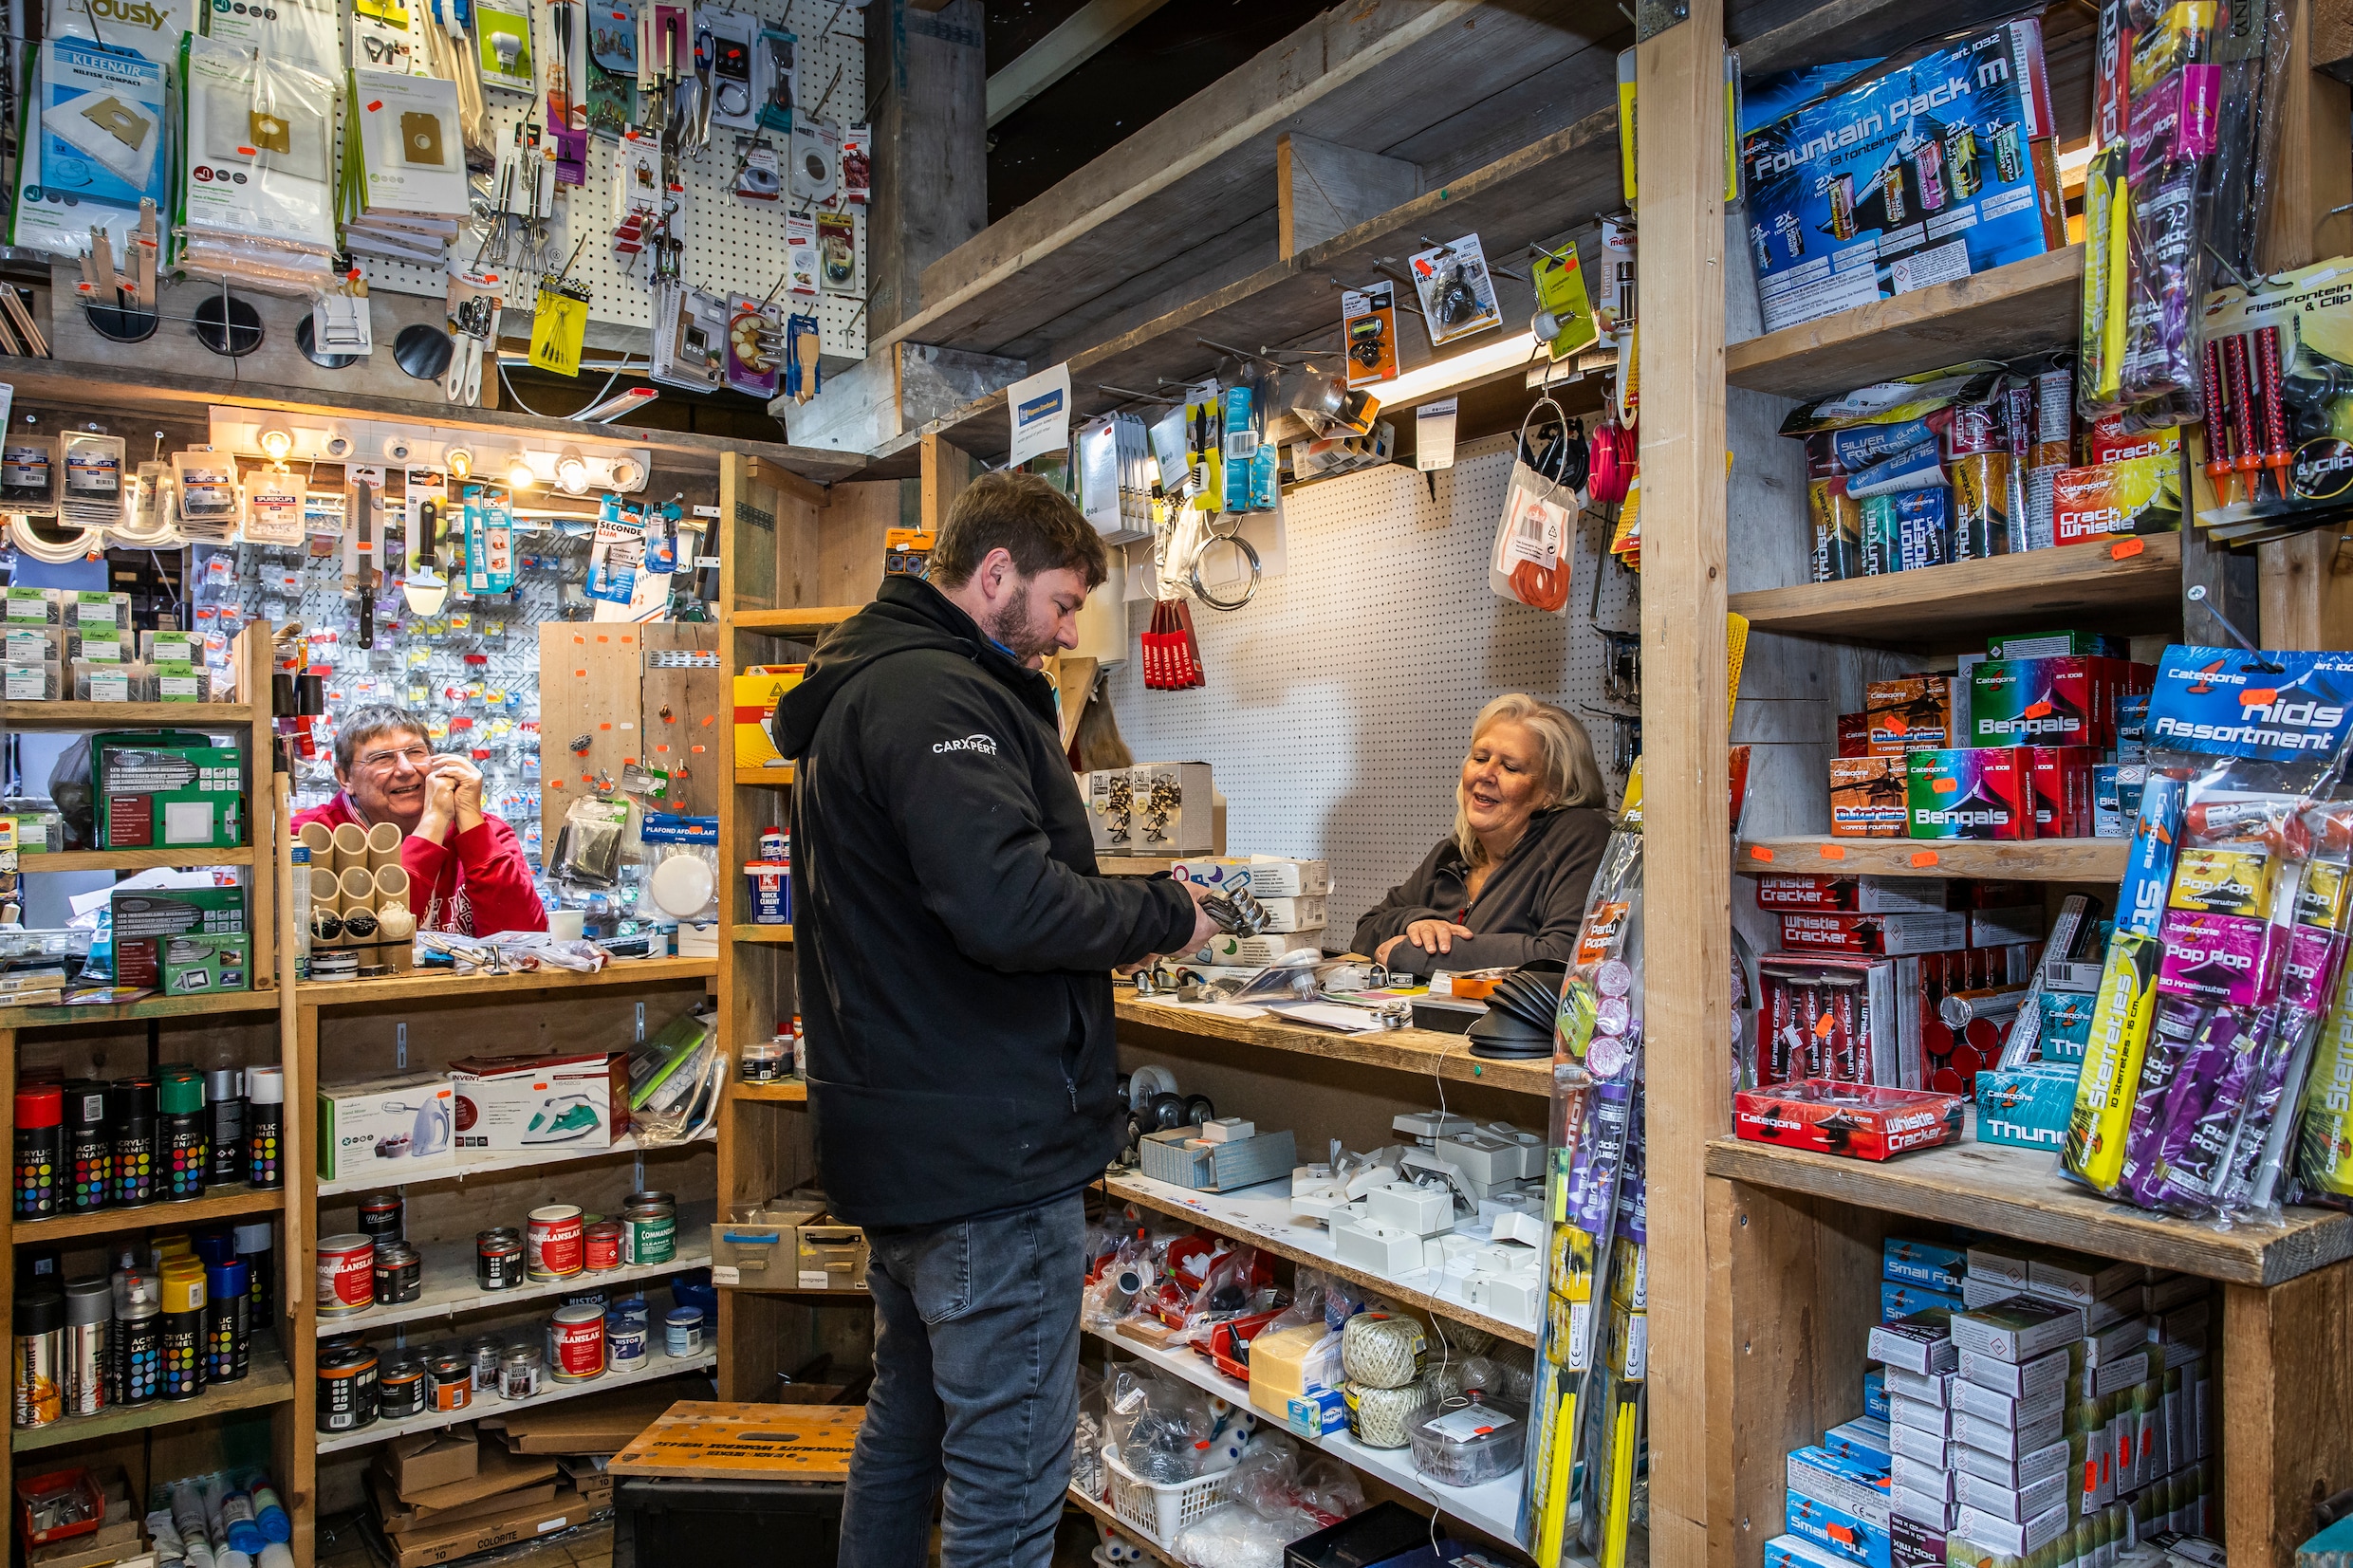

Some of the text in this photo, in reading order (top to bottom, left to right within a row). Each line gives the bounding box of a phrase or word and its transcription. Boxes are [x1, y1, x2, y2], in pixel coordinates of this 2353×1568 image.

[1951, 33, 2000, 61] art. 1032
[72, 53, 141, 77] KLEENAIR
[73, 68, 103, 80] NILFISK
[105, 75, 141, 86] COMPACT
[1755, 75, 1971, 181] Fountain Pack
[1945, 117, 1969, 137] 2X
[1985, 121, 2020, 143] fountain
[1906, 139, 1936, 161] fountain
[1814, 172, 1836, 190] 2X
[1774, 211, 1794, 229] 2X
[1774, 217, 1801, 236] fountain
[1603, 264, 1612, 298] kristall
[2305, 293, 2352, 312] & Clip
[1896, 424, 1920, 440] GLAM
[1842, 435, 1885, 452] SILVER
[1846, 439, 1912, 461] FOUNTAIN
[2102, 441, 2160, 462] Crack
[2314, 456, 2353, 473] Clip
[2060, 481, 2110, 494] Categorie
[2060, 506, 2121, 526] Crack
[598, 528, 618, 538] LIJM
[600, 521, 642, 536] SECONDE
[1976, 675, 2017, 685] Categorie
[2168, 662, 2334, 686] Categorie art.
[1871, 691, 1907, 700] Categorie
[1978, 715, 2081, 736] Bengals
[2155, 718, 2334, 750] Assortment
[933, 738, 996, 756] CARXPERT
[1834, 768, 1869, 777] Categorie
[1836, 808, 1907, 821] Dutchies
[1915, 808, 2009, 827] Bengals
[646, 826, 676, 835] PLAFOND
[2143, 792, 2168, 869] Categorie
[1760, 876, 1816, 890] Whistle
[2179, 876, 2214, 894] Pop
[1760, 888, 1823, 904] Cracker
[1590, 922, 1616, 936] Party
[1784, 914, 1840, 931] Whistle
[2168, 922, 2220, 936] Categorie
[1784, 929, 1847, 944] Cracker
[2165, 944, 2252, 969] Pop Pop
[2175, 978, 2231, 995] Knalerwten
[1772, 987, 1781, 1028] Cracker
[2130, 1001, 2140, 1016] cm
[2126, 1017, 2135, 1031] 16
[1810, 1032, 1820, 1070] Whistle
[2087, 974, 2133, 1110] Sterretjes
[1846, 1036, 1855, 1074] Whistle
[2112, 1038, 2132, 1095] Sterretjes
[1987, 1089, 2034, 1102] Categorie
[1740, 1112, 1873, 1131] Categorie art. 1059
[1885, 1112, 1936, 1136] Whistle
[1887, 1126, 1942, 1153] Cracker
[2079, 1113, 2101, 1169] Categorie
[2325, 1115, 2344, 1174] Categorie
[1888, 1262, 1930, 1280] Small
[569, 1294, 603, 1306] HISTOR
[615, 1337, 640, 1346] HISTOR
[1323, 1410, 1343, 1422] Toppits
[1798, 1451, 1841, 1470] Small
[1790, 1517, 1829, 1539] Small
[477, 1530, 518, 1549] COLORITE
[435, 1550, 447, 1560] 10
